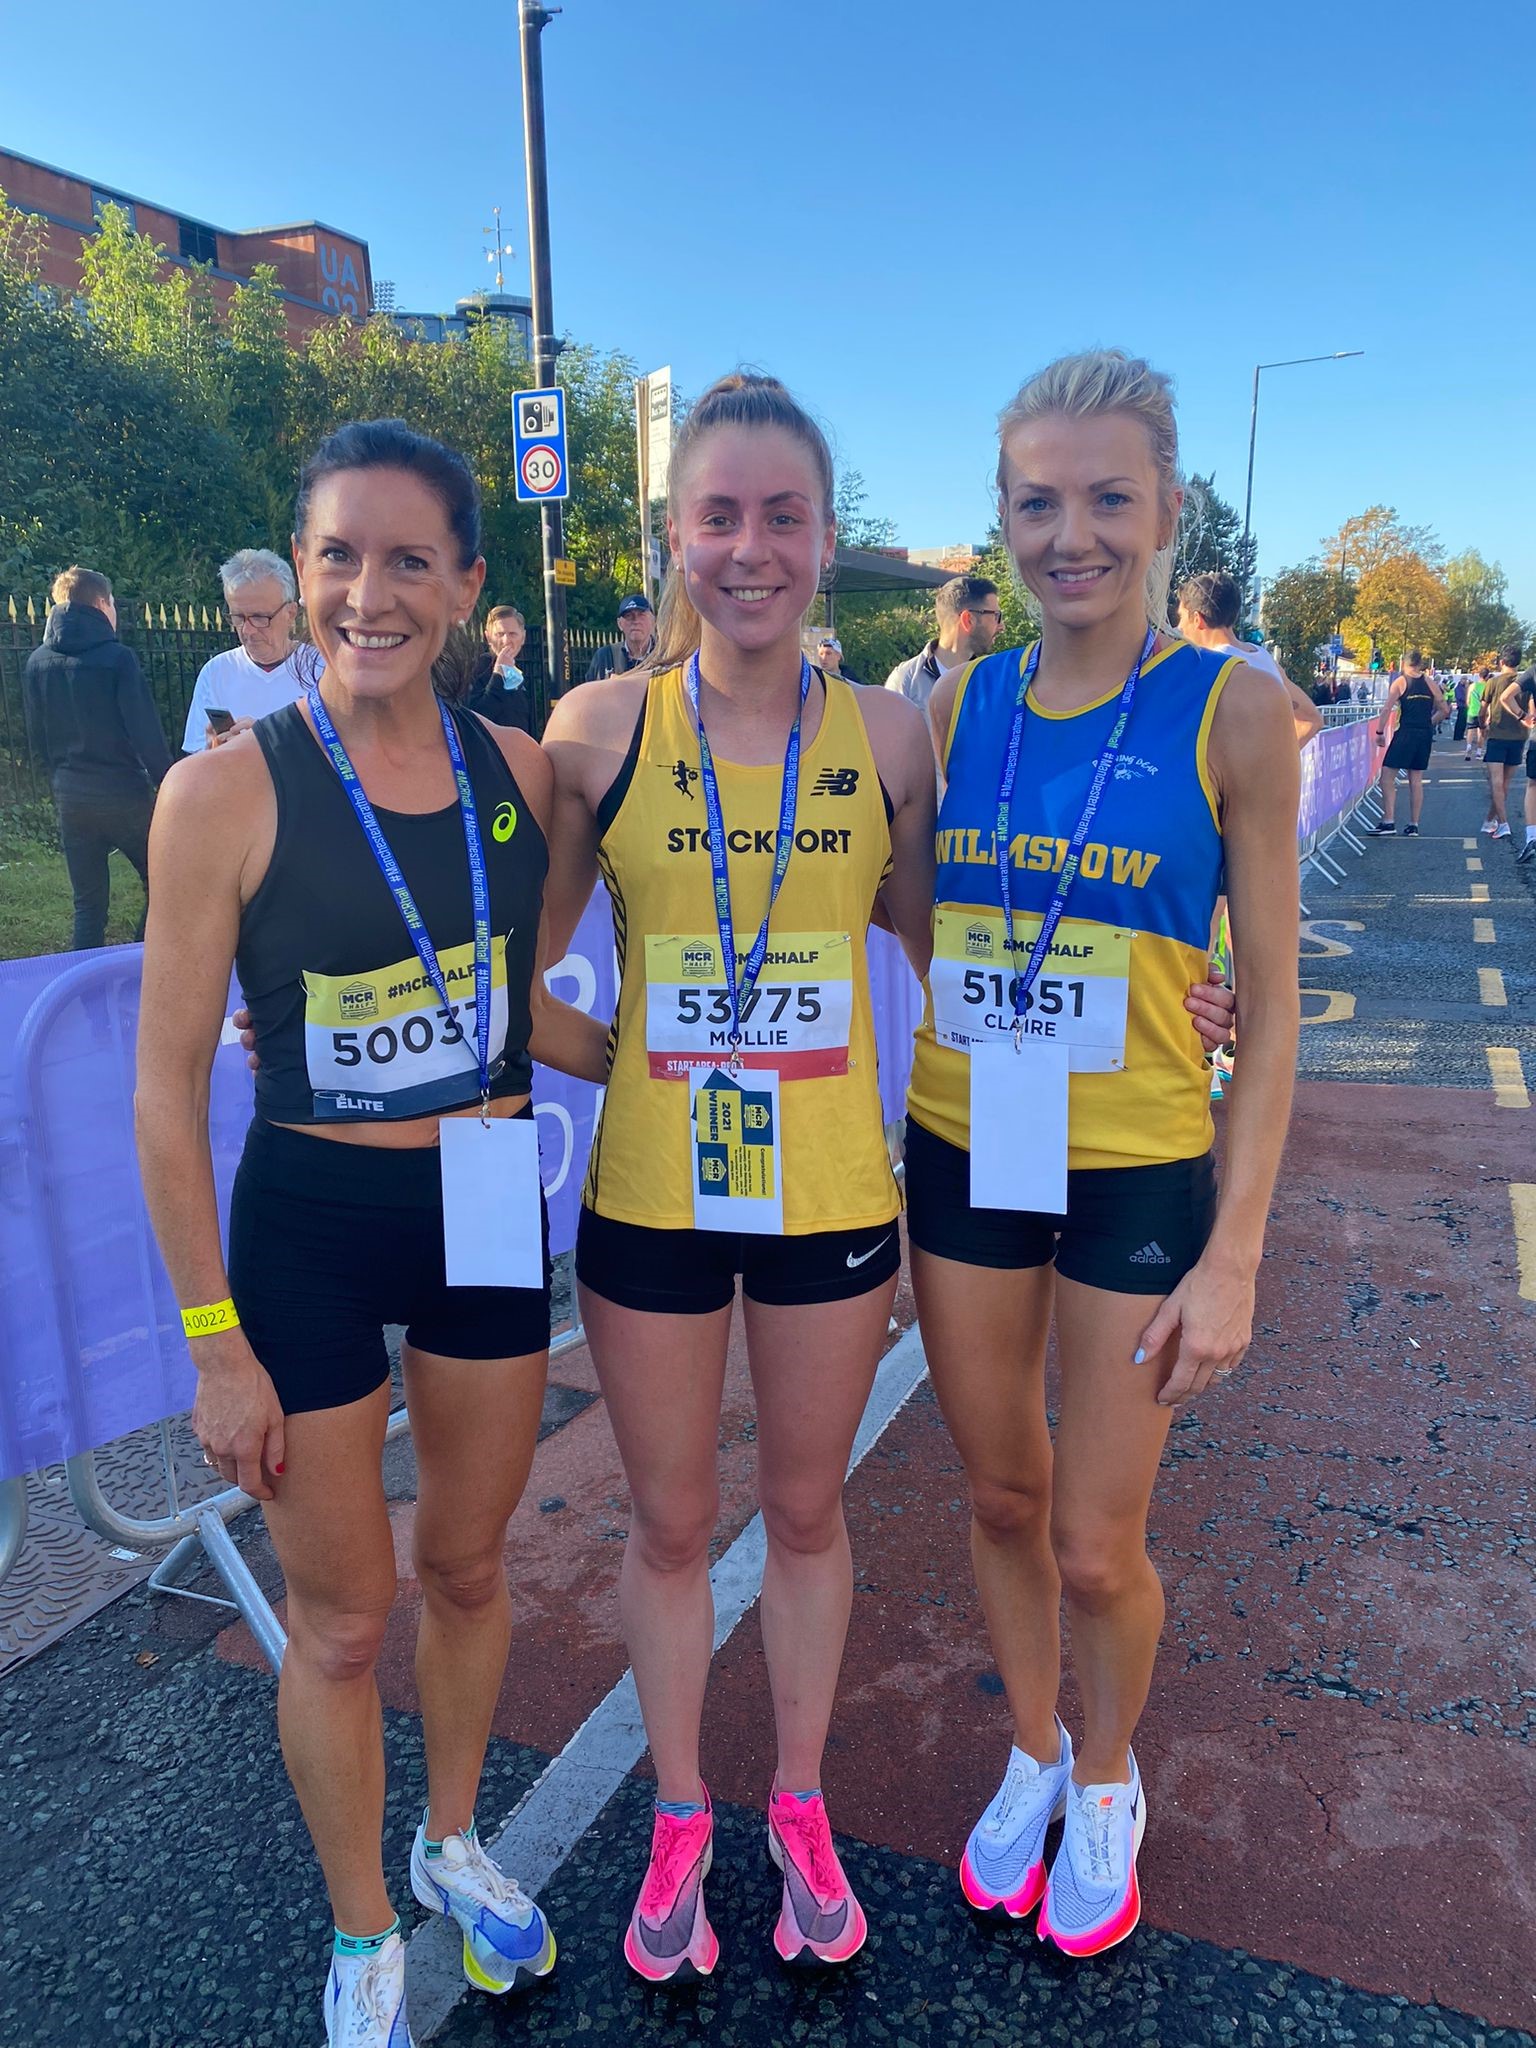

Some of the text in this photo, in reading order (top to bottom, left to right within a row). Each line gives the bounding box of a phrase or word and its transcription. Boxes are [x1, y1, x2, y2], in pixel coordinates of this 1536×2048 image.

[320, 244, 360, 292] UA
[528, 460, 555, 480] 30
[968, 932, 991, 944] MCR
[684, 952, 712, 962] MCR
[342, 991, 374, 1004] MCR
[676, 987, 822, 1024] 53775
[984, 1013, 1057, 1037] CLAIRE
[709, 1030, 788, 1046] MOLLIE
[336, 1098, 384, 1112] ELITE
[708, 1090, 719, 1142] WINNER
[722, 1102, 732, 1131] 2021
[754, 1106, 763, 1127] MCR
[712, 1159, 720, 1179] MCR
[1129, 1254, 1171, 1264] adidas
